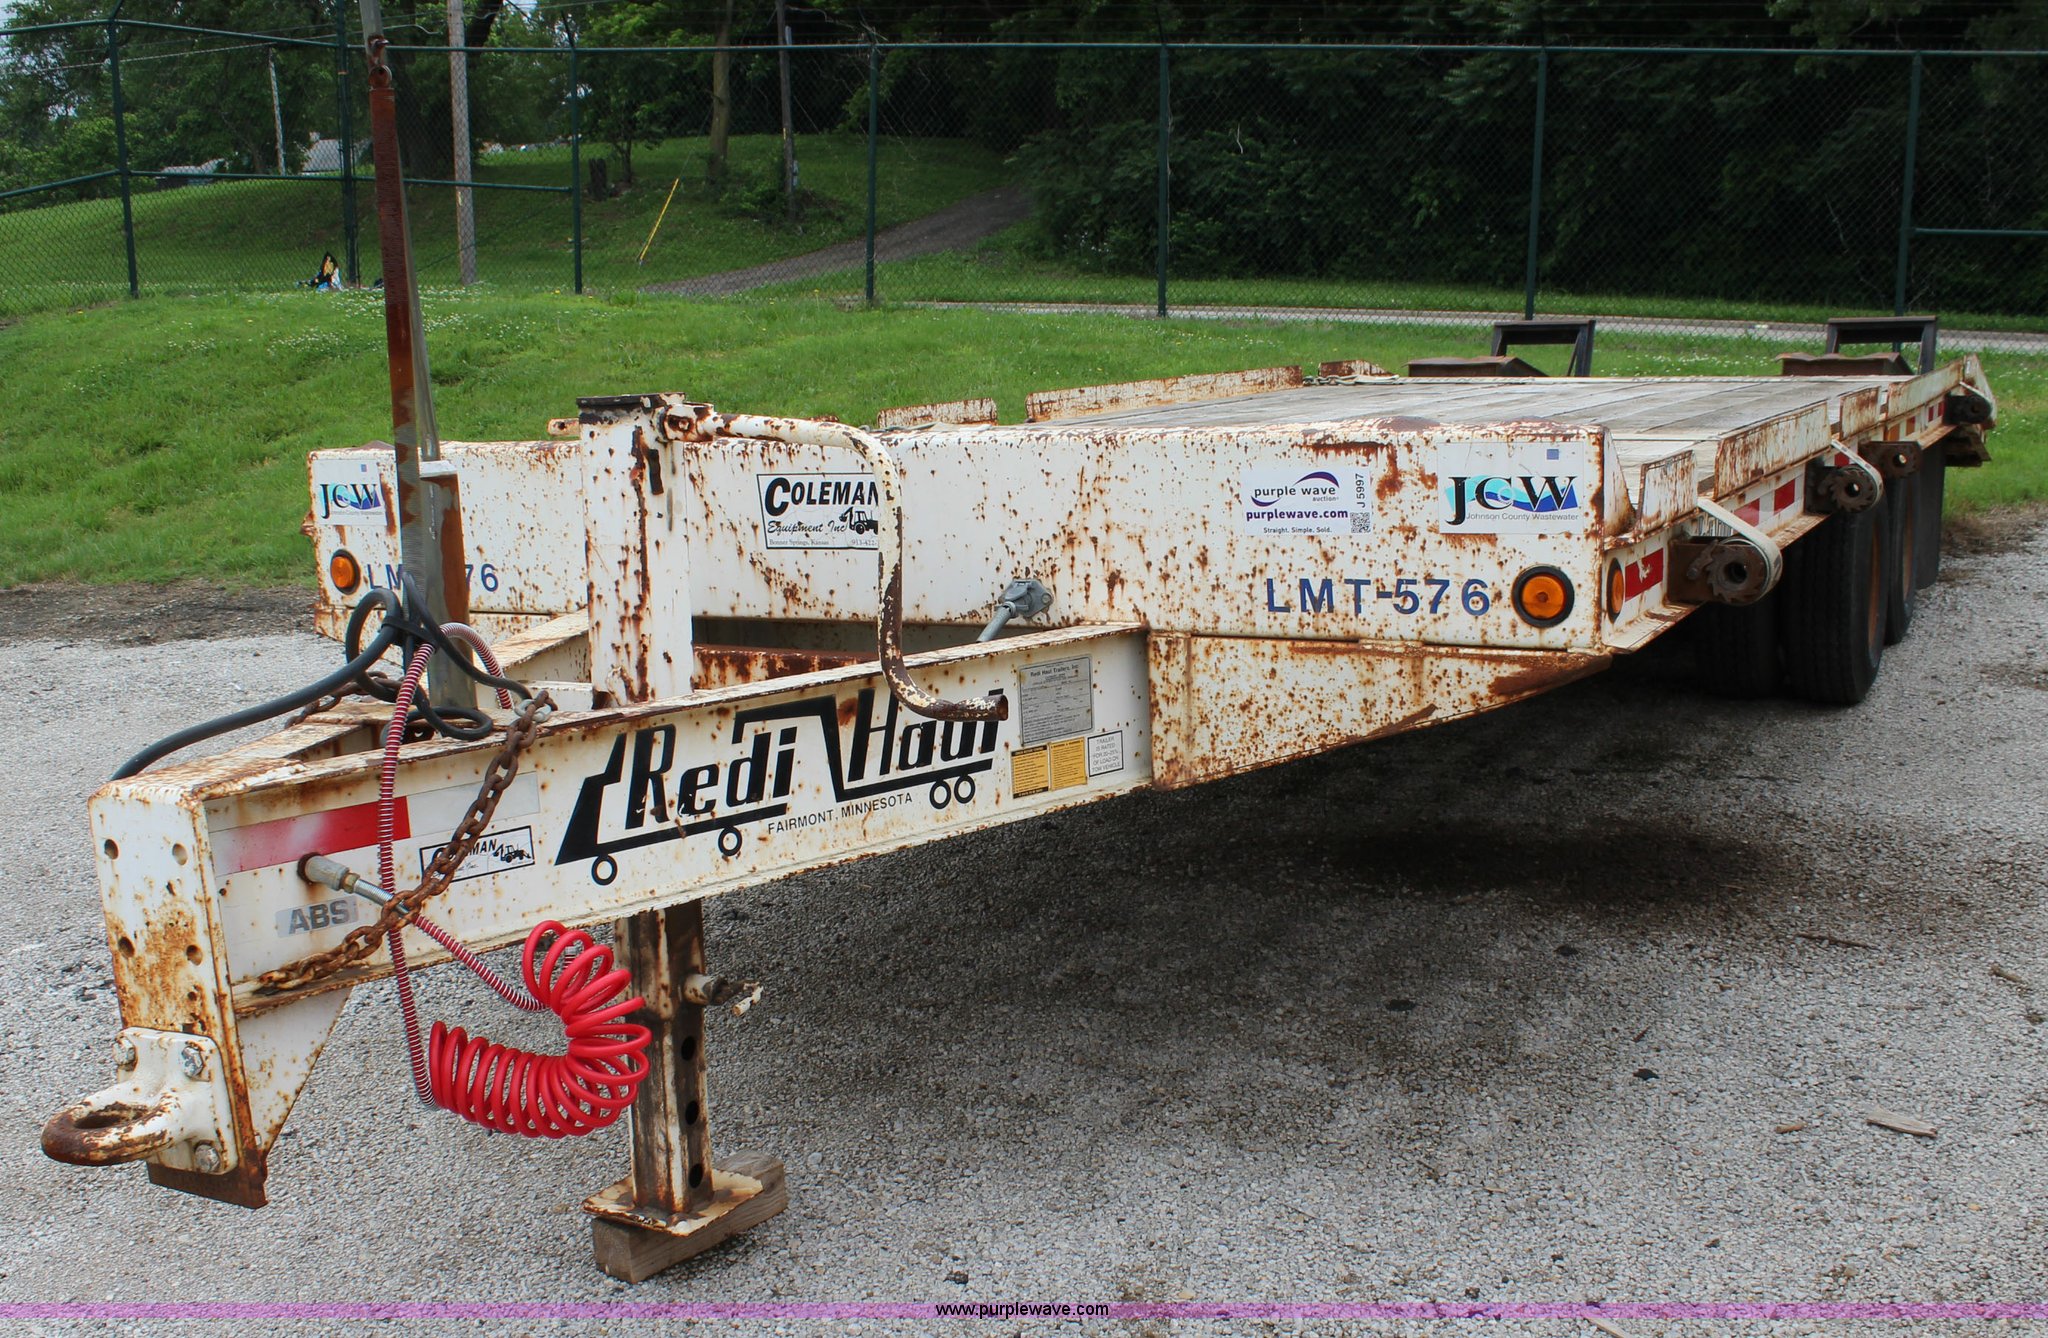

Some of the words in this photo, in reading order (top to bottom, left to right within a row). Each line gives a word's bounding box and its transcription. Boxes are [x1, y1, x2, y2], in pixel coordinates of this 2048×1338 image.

[319, 483, 377, 519] JCW
[765, 477, 878, 517] COLEMAN
[1254, 486, 1296, 498] purple
[1301, 486, 1336, 495] wave
[1445, 475, 1577, 526] JCW
[767, 520, 823, 536] Equipment
[1246, 508, 1348, 521] purplewave.com
[1291, 526, 1315, 534] Simple.
[1466, 512, 1500, 520] Johnson
[1502, 513, 1530, 521] County
[1531, 512, 1579, 521] Wastewater
[1266, 578, 1491, 616] LMT-576
[625, 723, 798, 830] Redi
[847, 687, 1004, 783] Haul
[767, 809, 838, 834] FAIRMONT,
[840, 793, 913, 818] MINNESOTA
[288, 899, 350, 935] ABS
